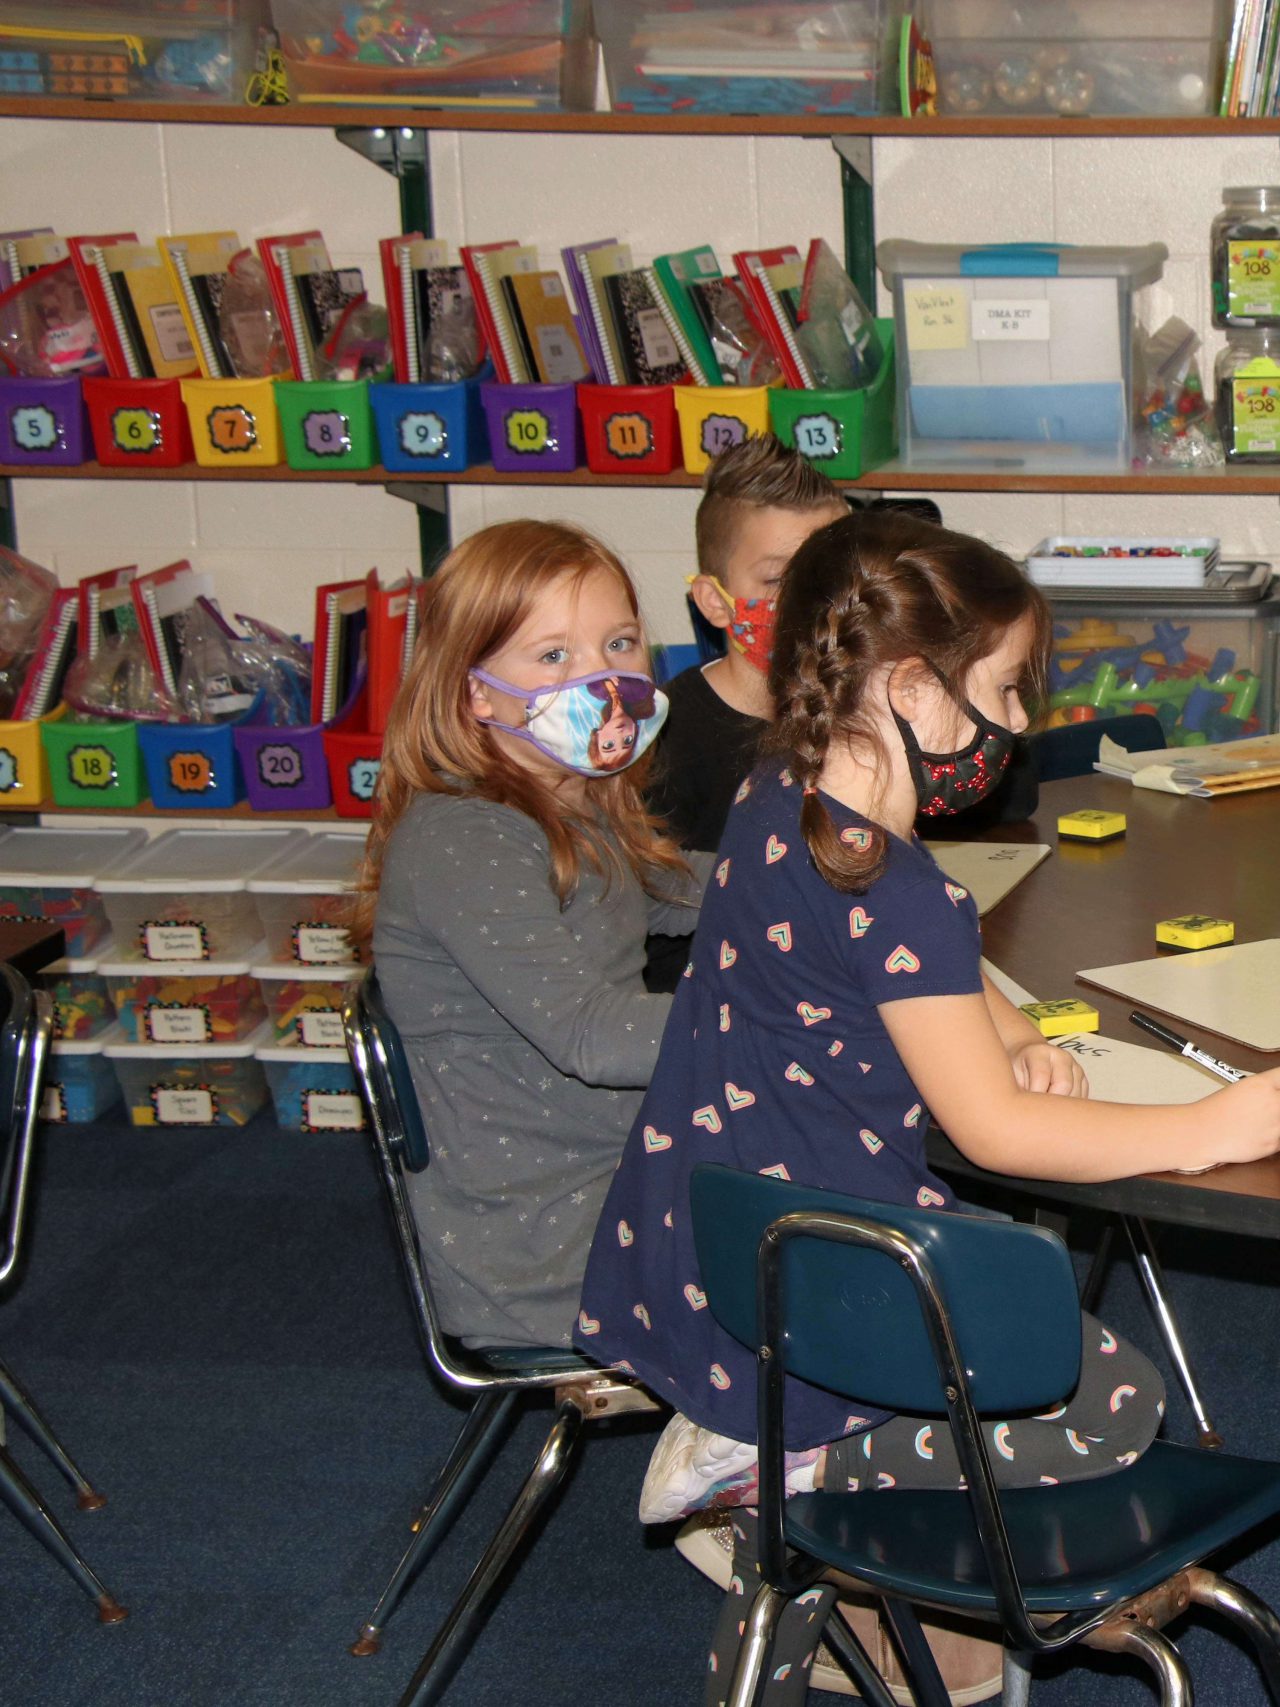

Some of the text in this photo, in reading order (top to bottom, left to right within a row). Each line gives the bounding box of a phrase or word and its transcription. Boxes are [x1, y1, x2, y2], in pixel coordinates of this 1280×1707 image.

[1243, 260, 1271, 276] 108
[1014, 309, 1031, 318] KIT
[28, 419, 42, 437] 5
[128, 419, 142, 438] 6
[224, 419, 237, 438] 7
[319, 424, 333, 442] 8
[415, 425, 429, 443] 9
[517, 422, 539, 440] 10
[619, 426, 637, 444] 11
[806, 426, 828, 446] 13
[82, 757, 102, 775] 18
[180, 761, 201, 780] 19
[269, 755, 293, 774] 20
